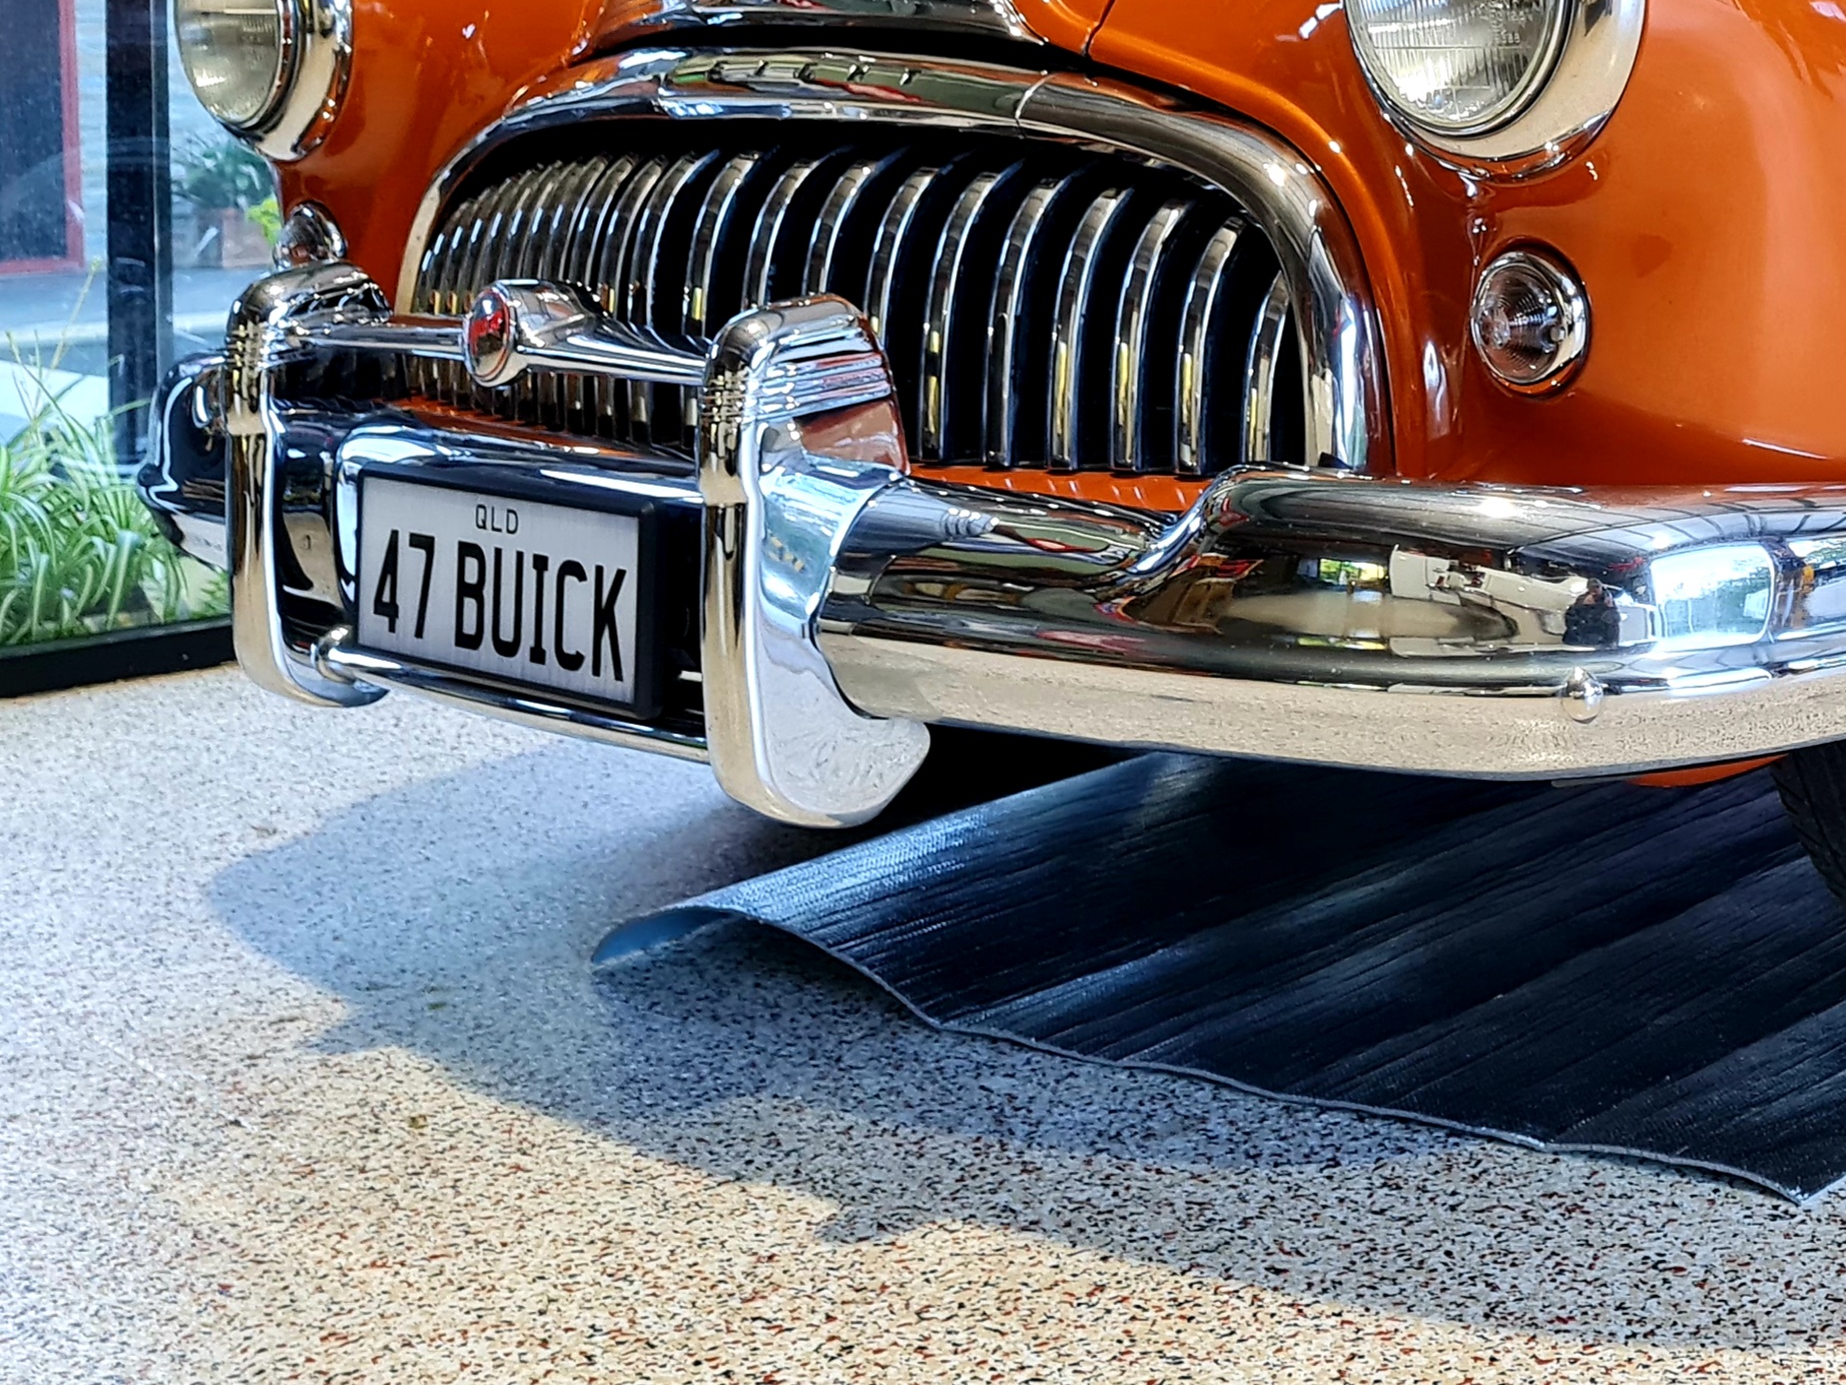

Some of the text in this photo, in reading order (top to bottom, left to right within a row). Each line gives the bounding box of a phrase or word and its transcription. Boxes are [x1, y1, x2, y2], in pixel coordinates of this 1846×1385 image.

[474, 501, 520, 535] QLD
[373, 528, 629, 684] 47 BUICK
